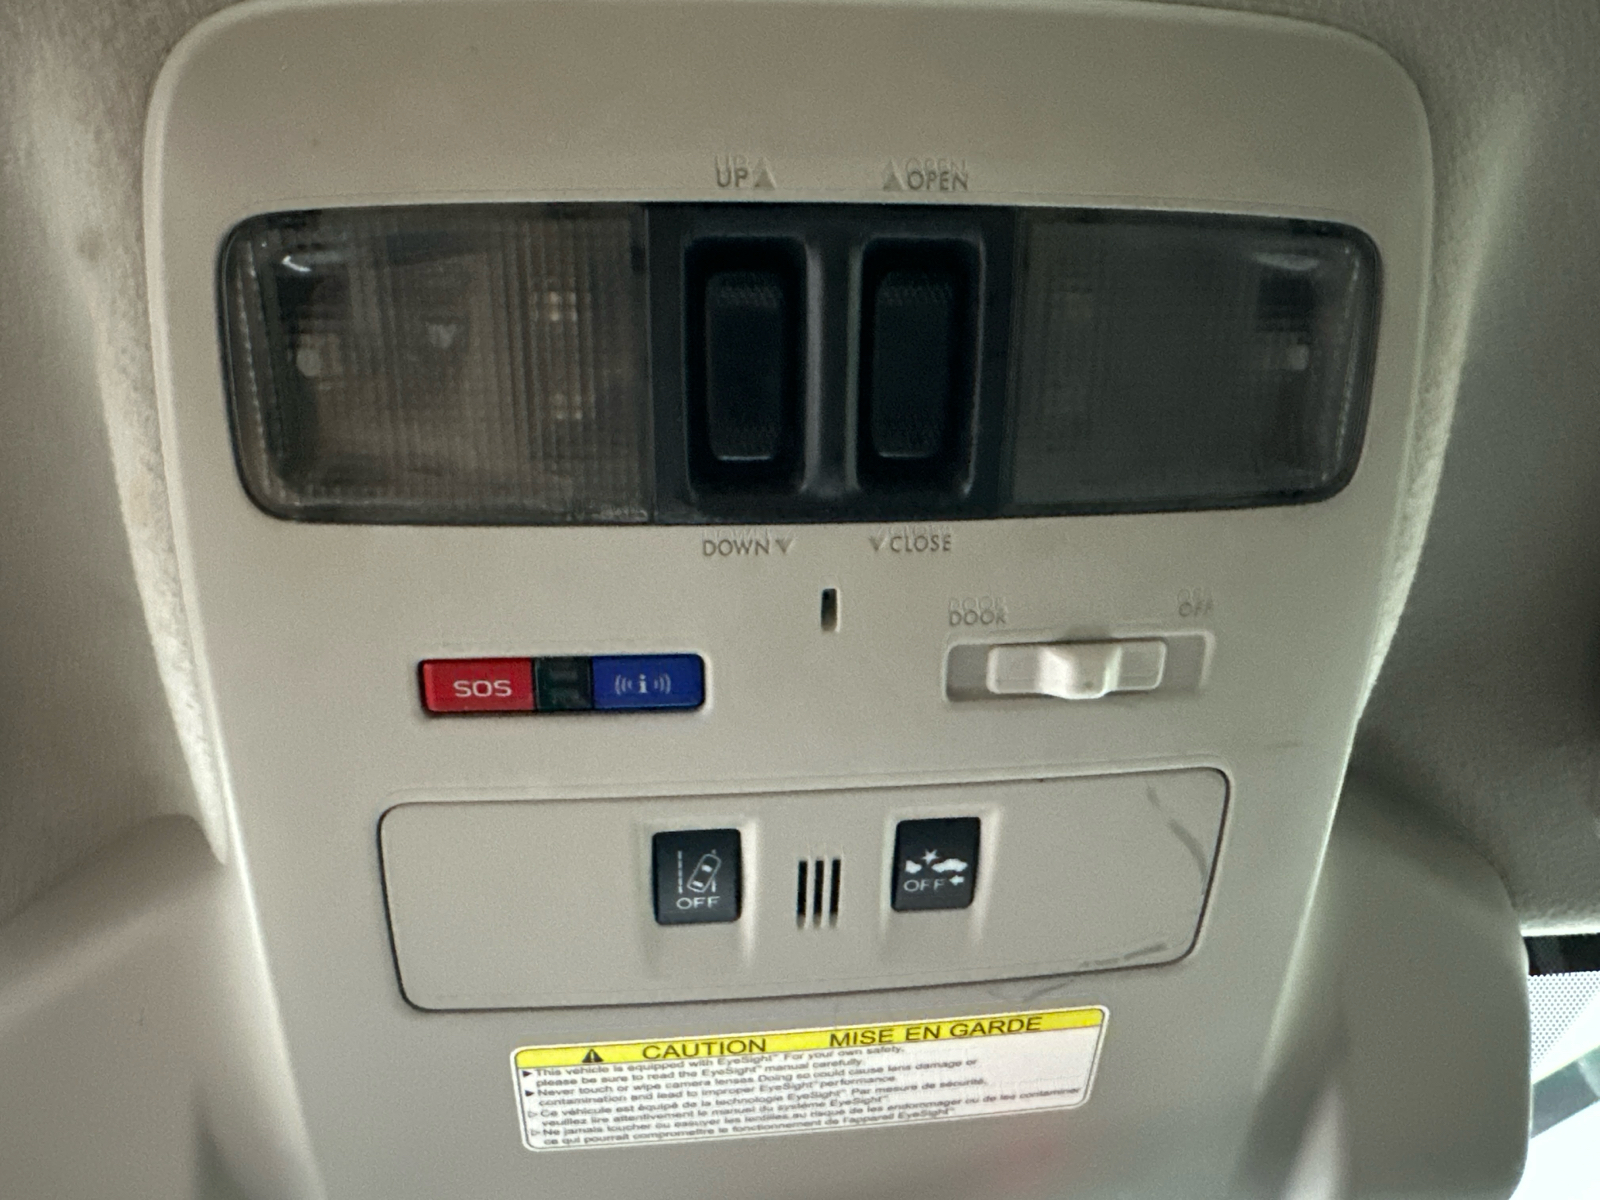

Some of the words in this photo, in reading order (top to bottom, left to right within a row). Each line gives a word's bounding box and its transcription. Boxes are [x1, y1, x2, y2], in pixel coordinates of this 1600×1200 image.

[715, 166, 748, 188] UP
[907, 170, 967, 191] OPEN
[703, 539, 769, 557] DOWN
[890, 535, 951, 553] CLOSE
[949, 608, 1006, 626] DOOR
[453, 679, 512, 697] SOS
[904, 878, 945, 892] OFF
[676, 895, 721, 910] OFF
[642, 1037, 766, 1060] CAUTION
[829, 1028, 893, 1047] MISE
[905, 1025, 940, 1040] EN
[949, 1016, 1042, 1037] GARDE
[536, 1068, 561, 1076] This
[565, 1065, 609, 1075] vehicle
[626, 1060, 684, 1072] equipped
[784, 1052, 803, 1060] For
[807, 1051, 833, 1059] your
[535, 1078, 577, 1087] please
[647, 1071, 674, 1079] read
[764, 1062, 809, 1071] manual
[537, 1087, 574, 1096] Never
[578, 1084, 612, 1093] touch
[632, 1082, 661, 1091] wipe
[665, 1079, 710, 1088] camera
[758, 1073, 792, 1083] Doing
[813, 1069, 844, 1077] could
[847, 1066, 883, 1074] cause
[915, 1060, 962, 1070] damage
[538, 1094, 627, 1107] contamination
[656, 1091, 682, 1099] lead
[540, 1109, 557, 1117] Ce
[874, 1084, 917, 1092] mesure
[542, 1128, 560, 1136] Ne
